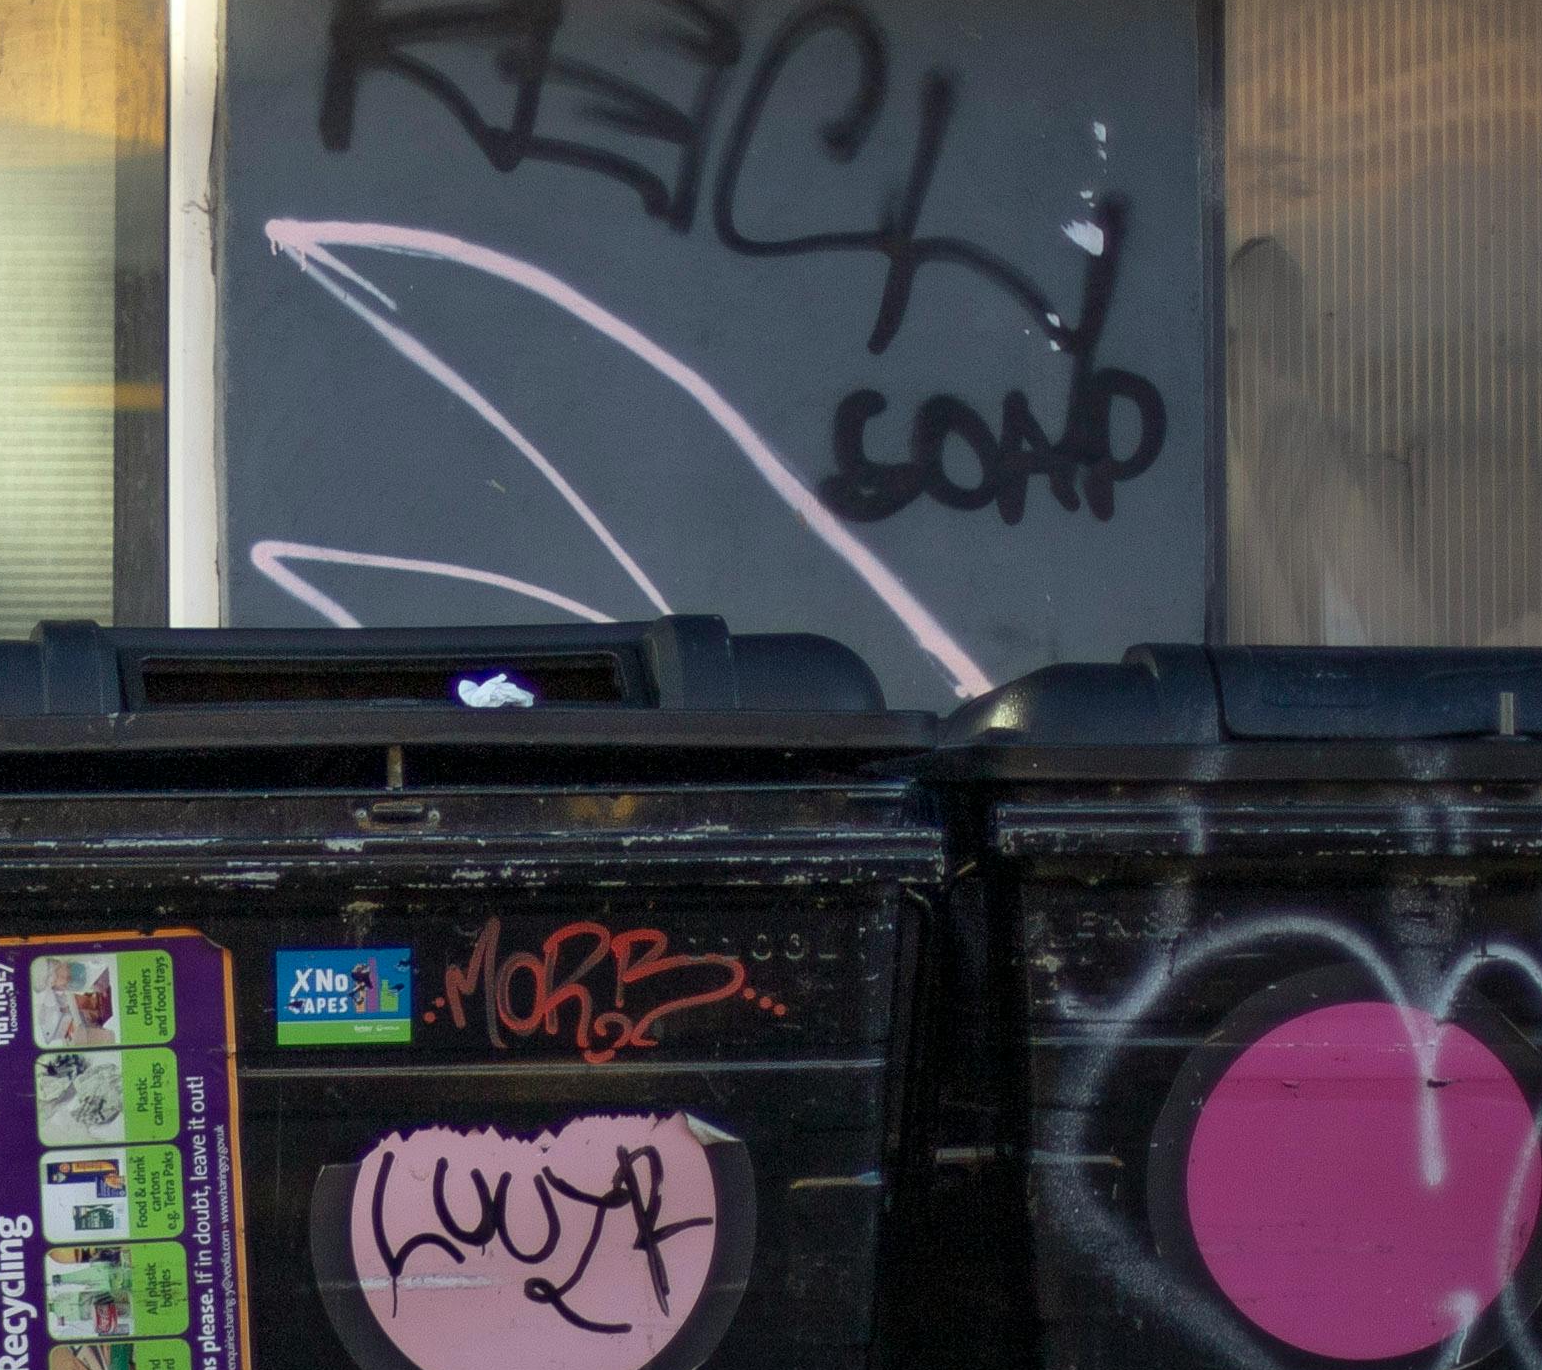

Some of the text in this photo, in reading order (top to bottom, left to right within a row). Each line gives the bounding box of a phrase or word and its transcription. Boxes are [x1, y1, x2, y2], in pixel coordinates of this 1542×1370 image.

[125, 980, 139, 1015] Plastic
[139, 968, 154, 1026] containers
[153, 956, 169, 1036] and food trays
[315, 967, 349, 993] No
[136, 1077, 149, 1113] Plastic
[149, 1062, 164, 1126] carrier bags
[186, 1076, 205, 1110] out!
[189, 1116, 206, 1131] it
[189, 1135, 207, 1181] leave
[133, 1156, 148, 1228] Food & drink
[150, 1171, 162, 1212] cartons
[163, 1151, 180, 1230] e.g. Tetra Paks
[192, 1185, 213, 1244] doubt,
[195, 1249, 212, 1266] in
[197, 1269, 213, 1284] If
[146, 1262, 160, 1315] All plastic
[160, 1269, 173, 1308] bottles
[196, 1288, 220, 1352] please.
